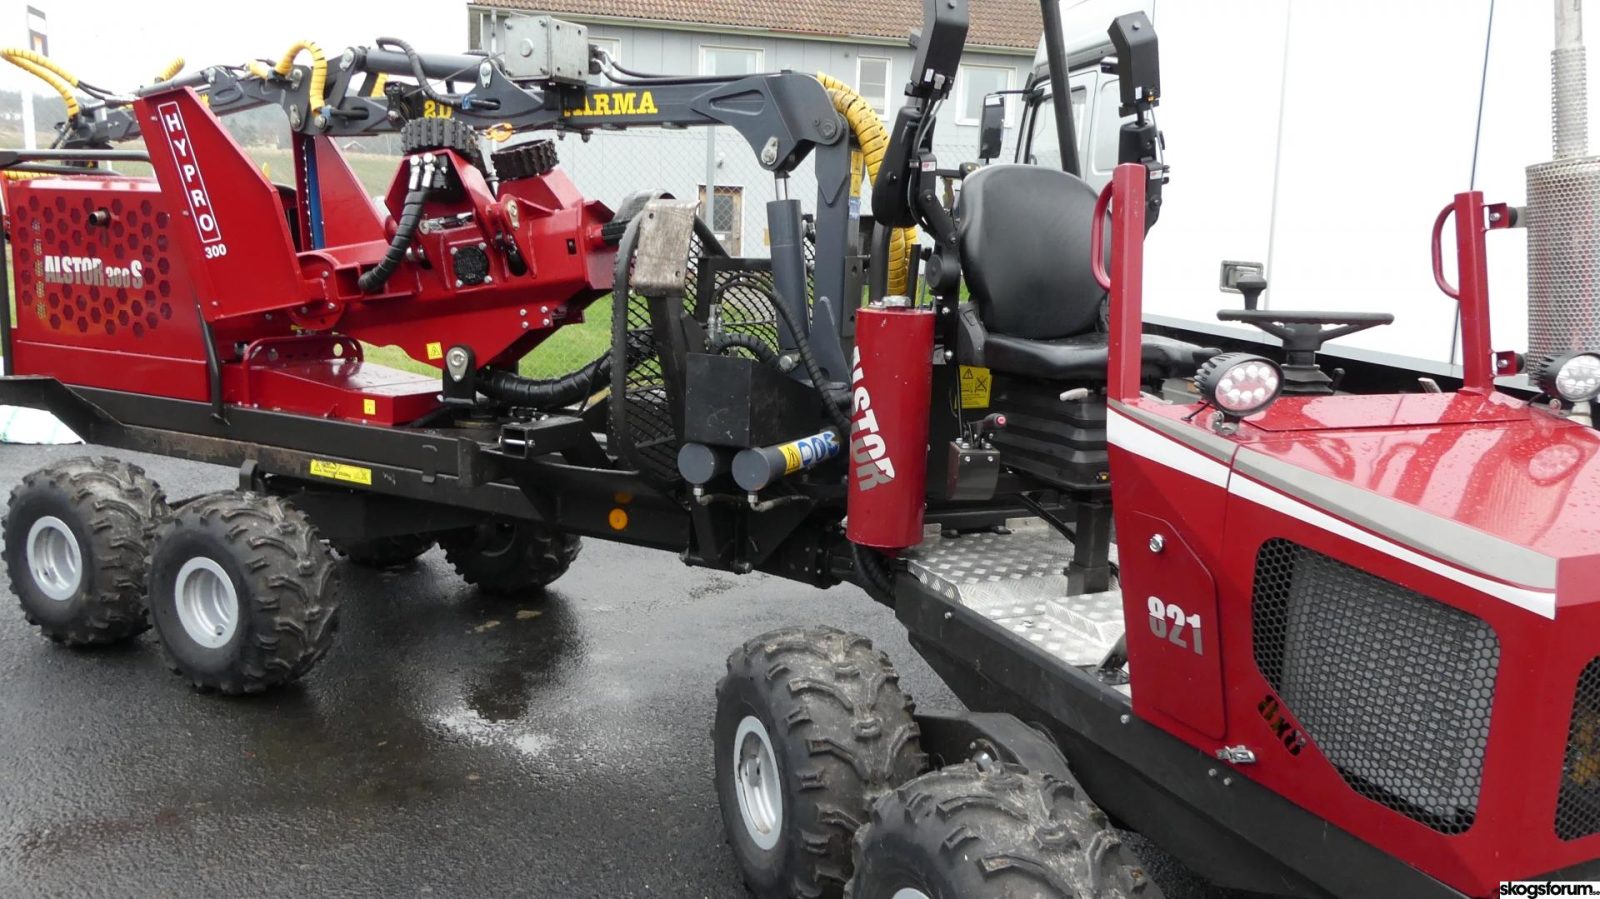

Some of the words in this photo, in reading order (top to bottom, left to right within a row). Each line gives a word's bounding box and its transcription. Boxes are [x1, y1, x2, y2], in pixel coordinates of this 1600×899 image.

[565, 91, 658, 117] RMA
[165, 112, 215, 232] HYPRO
[44, 255, 104, 286] ALSTOR
[204, 243, 227, 259] 300
[852, 345, 896, 492] STOR
[1147, 595, 1204, 656] 821
